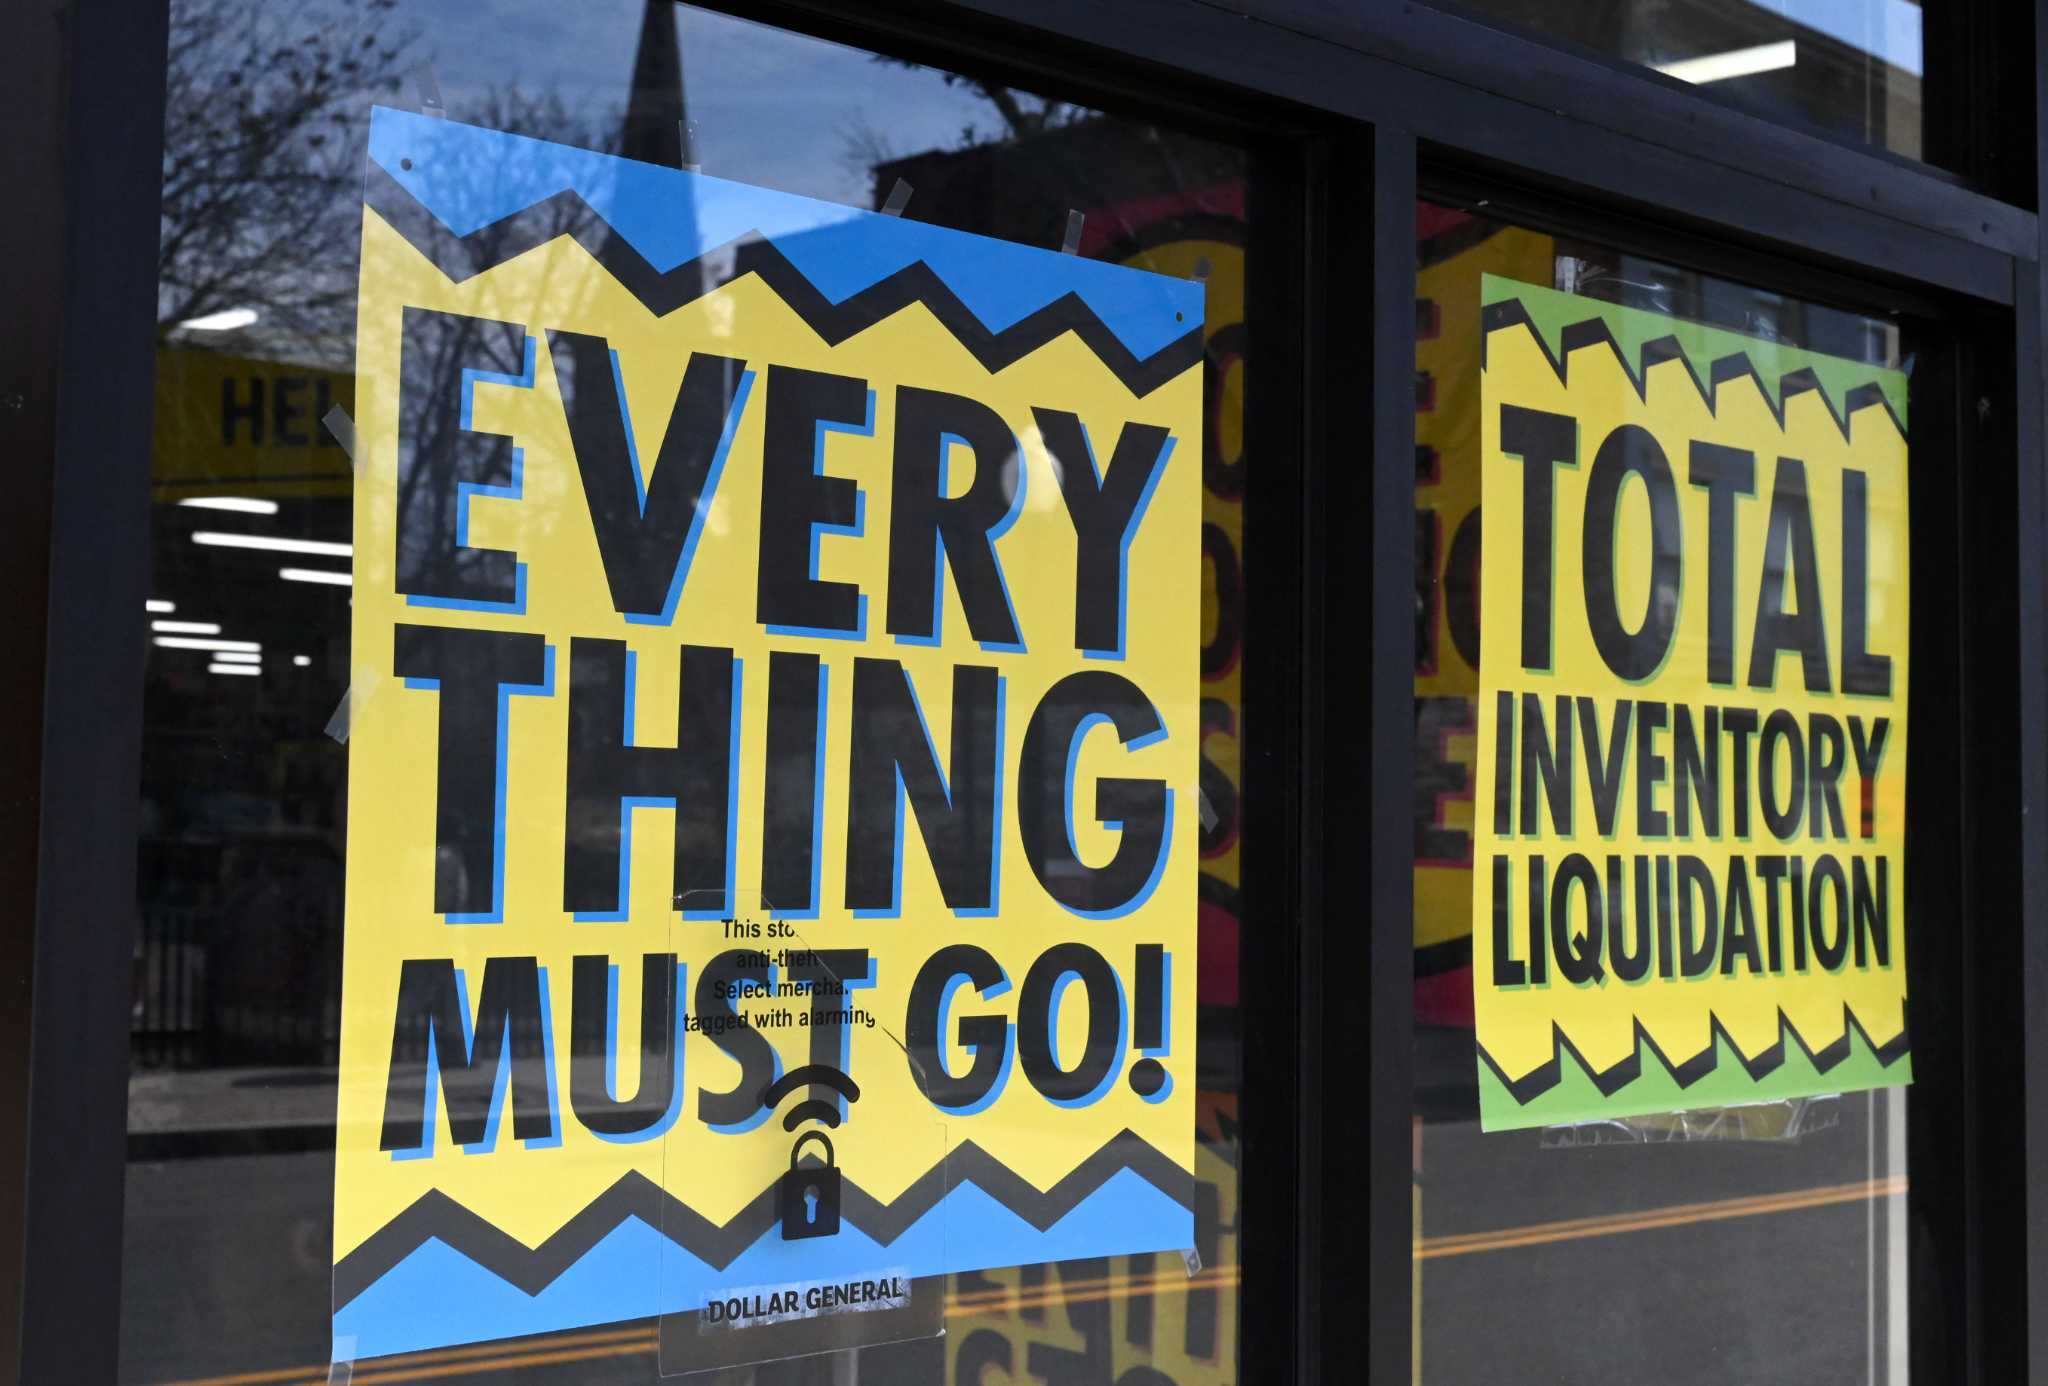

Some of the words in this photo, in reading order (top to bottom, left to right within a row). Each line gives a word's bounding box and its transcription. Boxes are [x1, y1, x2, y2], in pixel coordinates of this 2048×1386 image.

[395, 305, 1177, 661] EVERY
[1500, 403, 1893, 697] TOTAL
[394, 623, 1174, 924] THING
[1493, 691, 1891, 842] INVENTORY
[714, 977, 772, 999] Select
[778, 976, 848, 998] mercha
[721, 919, 761, 939] This
[767, 918, 800, 939] sto
[1492, 853, 1892, 992] LIQUIDATION
[380, 949, 877, 1161] MUST
[905, 942, 1174, 1116] GO!
[684, 1007, 748, 1036] tagged
[755, 1008, 793, 1028] with
[707, 1290, 800, 1323] DOLLAR
[806, 1276, 902, 1310] GENERAL
